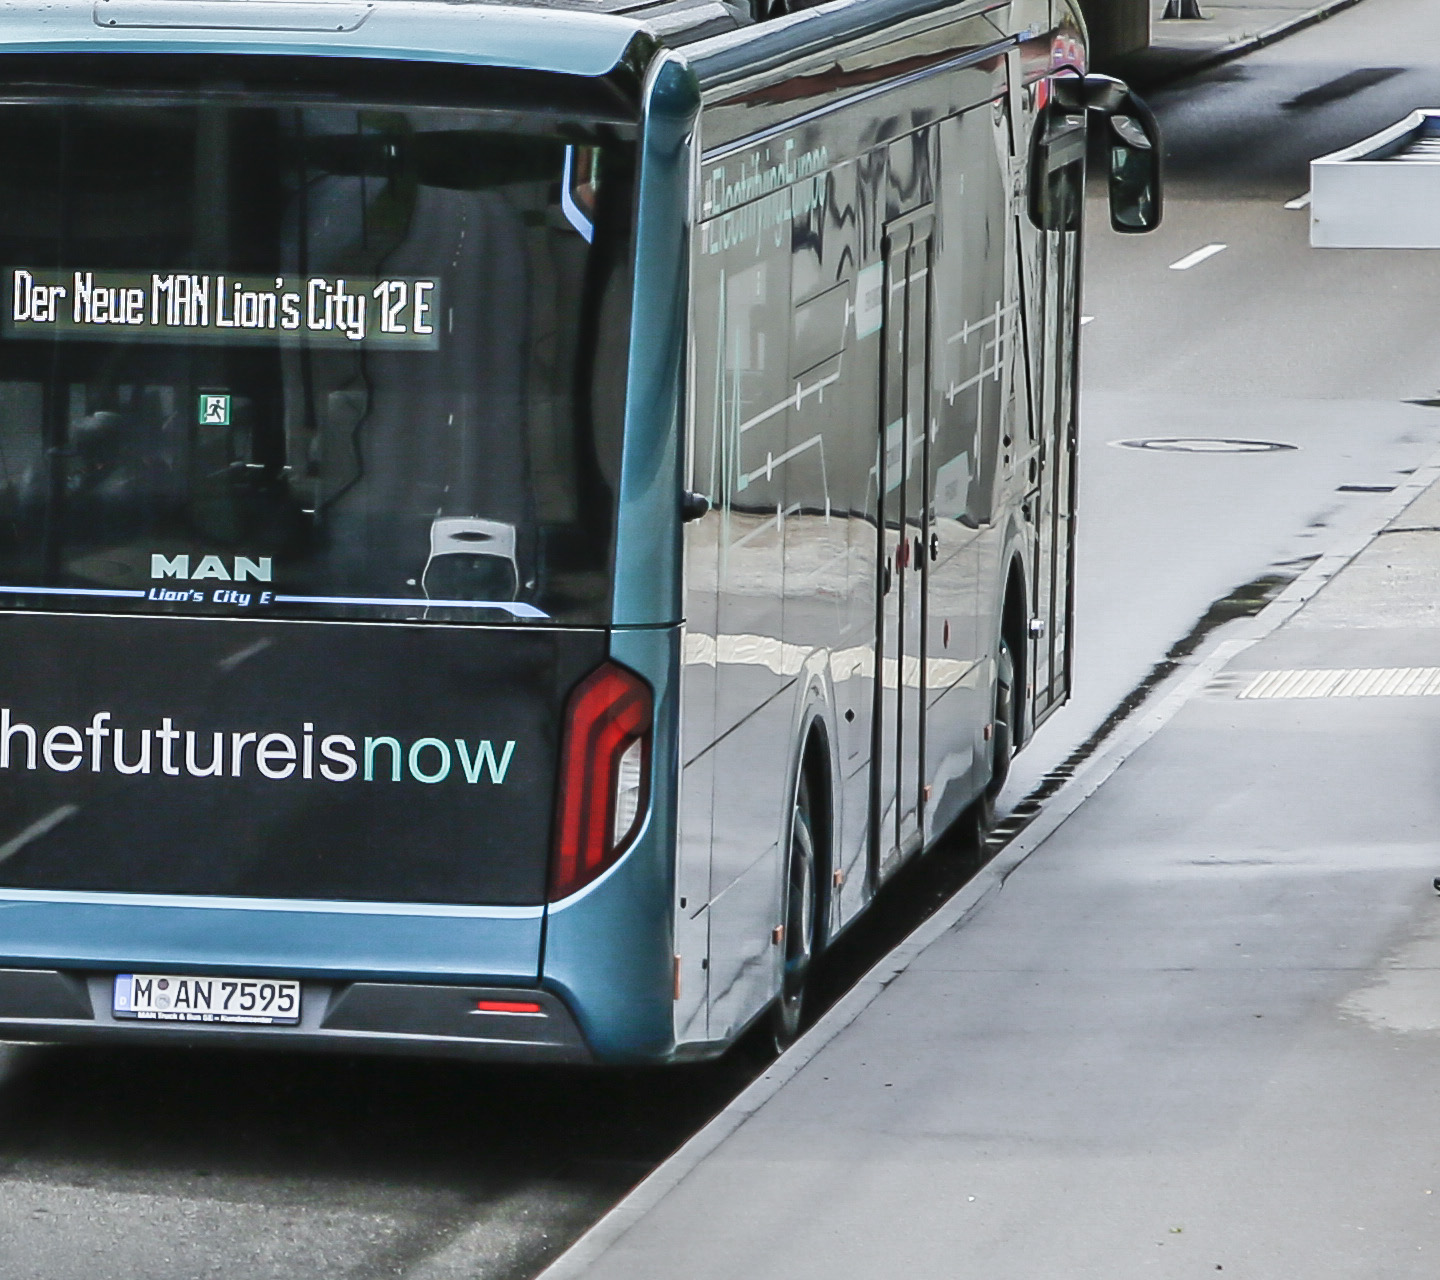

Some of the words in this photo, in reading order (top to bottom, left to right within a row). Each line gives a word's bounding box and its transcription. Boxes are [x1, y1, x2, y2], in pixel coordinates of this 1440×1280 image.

[12, 268, 67, 323] Der
[73, 271, 145, 326] Neue
[151, 273, 210, 328] MAN
[215, 274, 302, 331] Lion's
[306, 277, 368, 342] City
[372, 280, 409, 335] 12
[413, 280, 435, 336] E
[151, 553, 272, 582] MAN
[148, 587, 205, 603] Lion's
[212, 589, 252, 607] City
[259, 591, 273, 605] E
[134, 978, 153, 1008] M
[174, 980, 213, 1010] AN
[221, 982, 296, 1013] 7595
